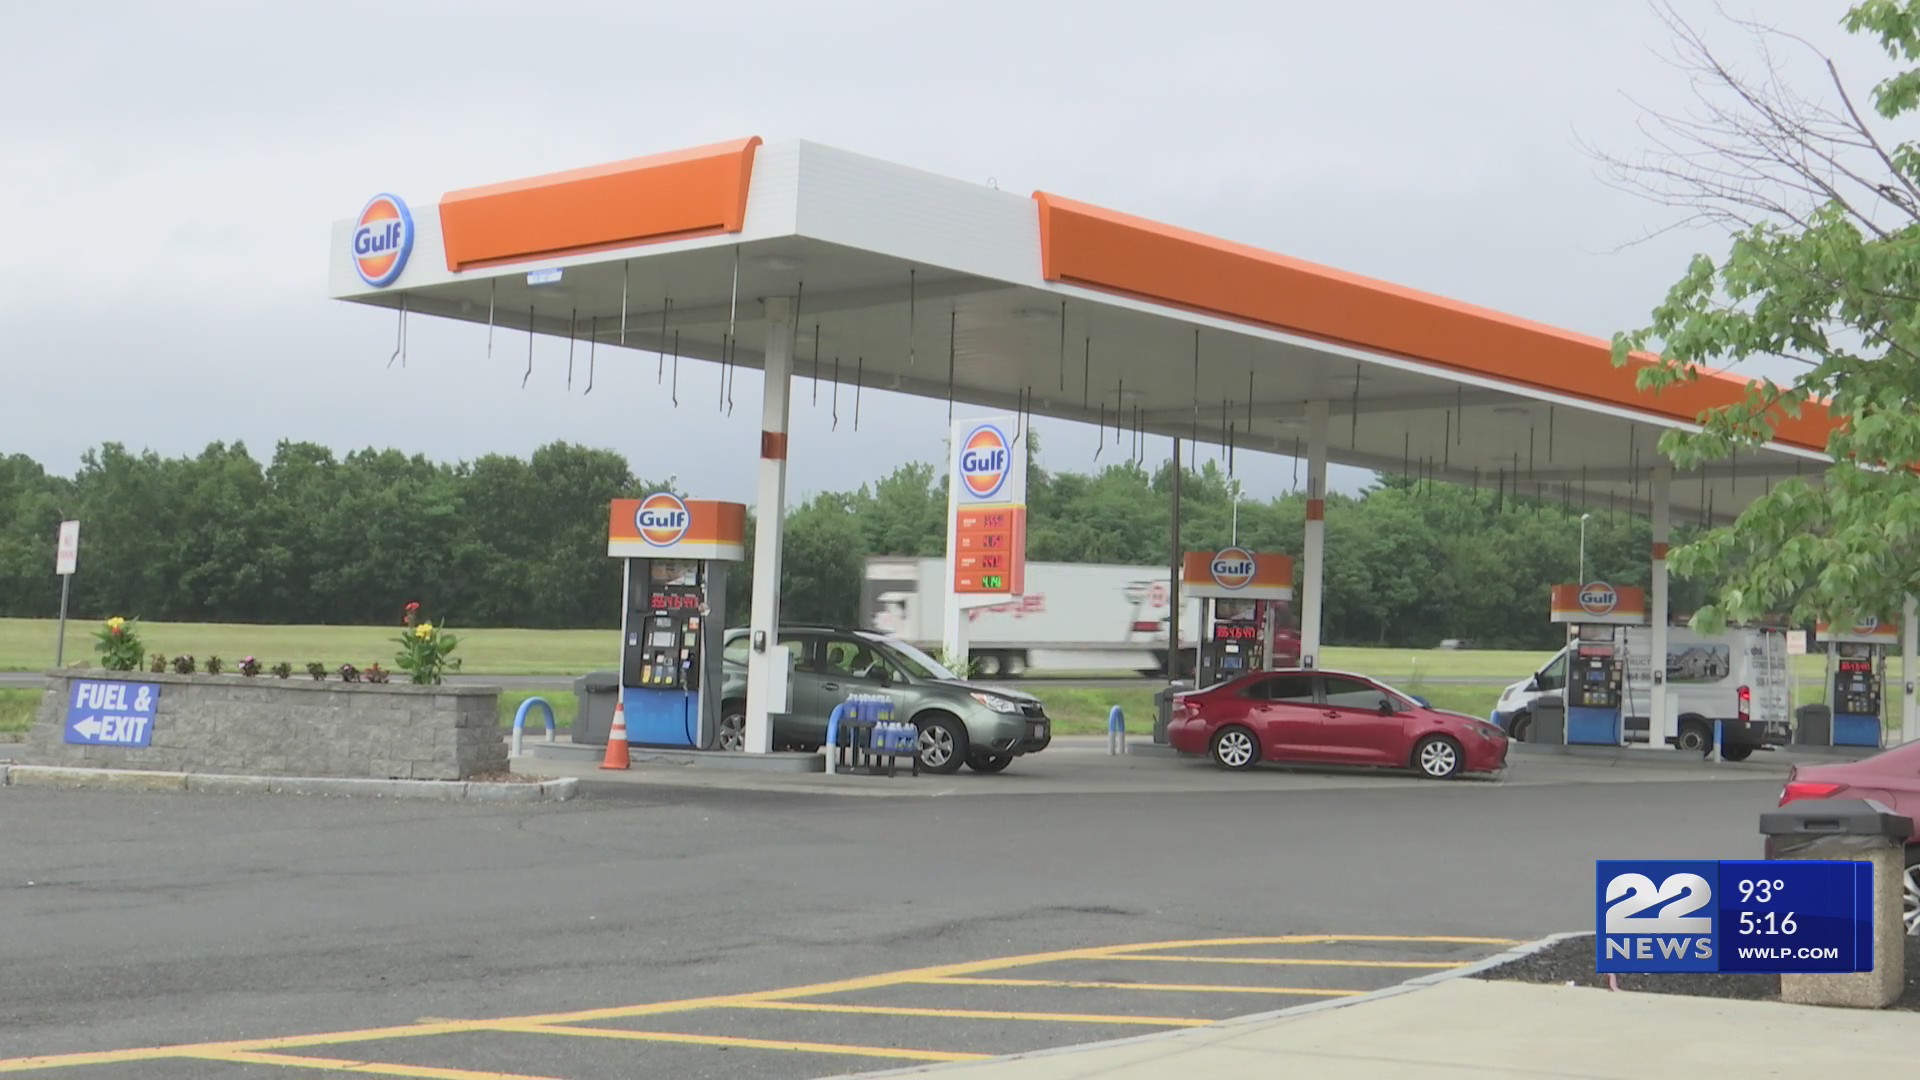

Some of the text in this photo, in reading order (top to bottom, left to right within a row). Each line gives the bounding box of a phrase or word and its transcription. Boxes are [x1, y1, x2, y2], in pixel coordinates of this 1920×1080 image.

[354, 221, 401, 255] Gulf
[962, 450, 1005, 472] Gulf
[639, 511, 685, 527] Gulf
[1213, 561, 1253, 575] Gulf
[1580, 592, 1616, 604] Gulf
[76, 683, 152, 712] FUEL &
[99, 715, 149, 743] EXIT
